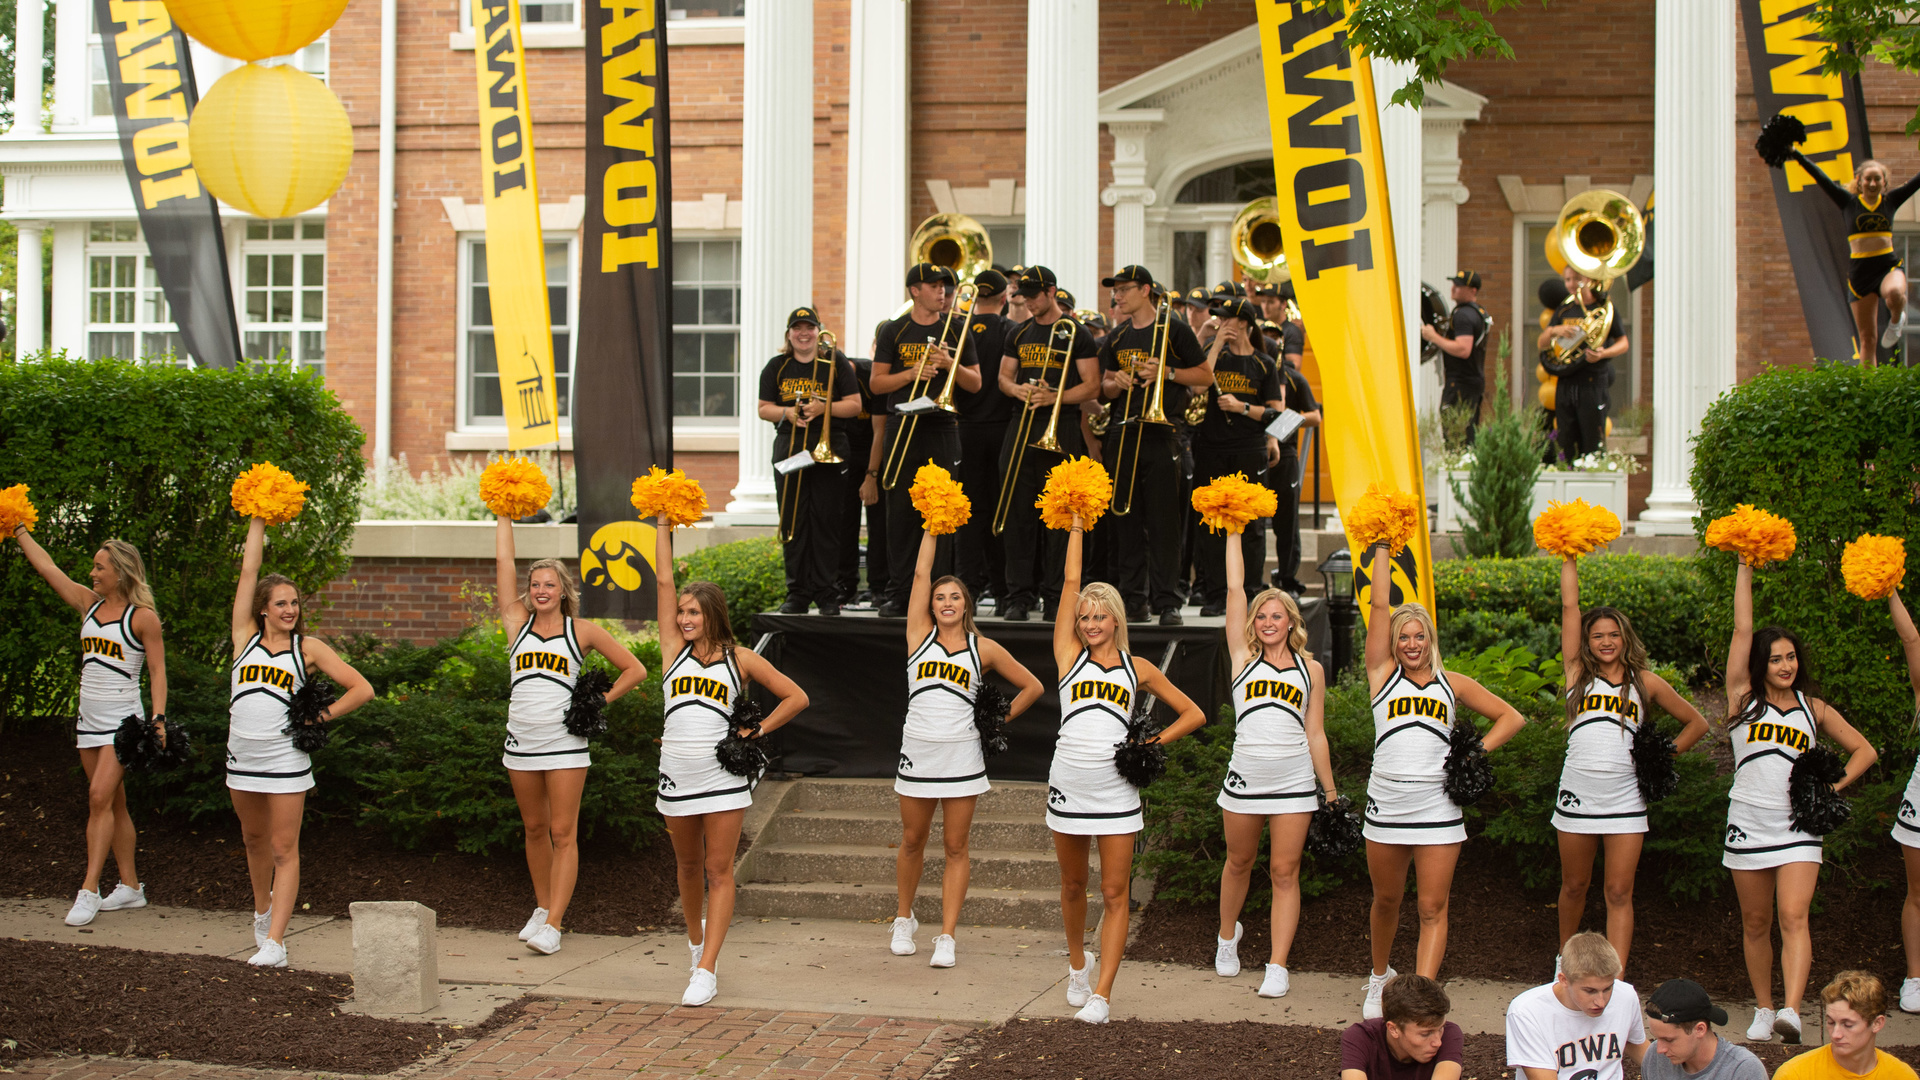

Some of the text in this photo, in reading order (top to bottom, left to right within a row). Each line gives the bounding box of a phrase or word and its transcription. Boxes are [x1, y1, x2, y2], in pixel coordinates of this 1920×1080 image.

[109, 0, 200, 210] IOWA
[482, 0, 527, 198] IOWA
[600, 0, 659, 273] IOWA
[1222, 379, 1250, 389] IOWA
[238, 663, 295, 696] IOWA
[515, 651, 570, 677] IOWA
[916, 660, 971, 691] IOWA
[670, 676, 729, 708] IOWA
[1070, 680, 1131, 713] IOWA
[1244, 679, 1304, 712] IOWA
[1387, 696, 1448, 726] IOWA
[1577, 694, 1640, 725] IOWA
[1746, 722, 1810, 754] IOWA
